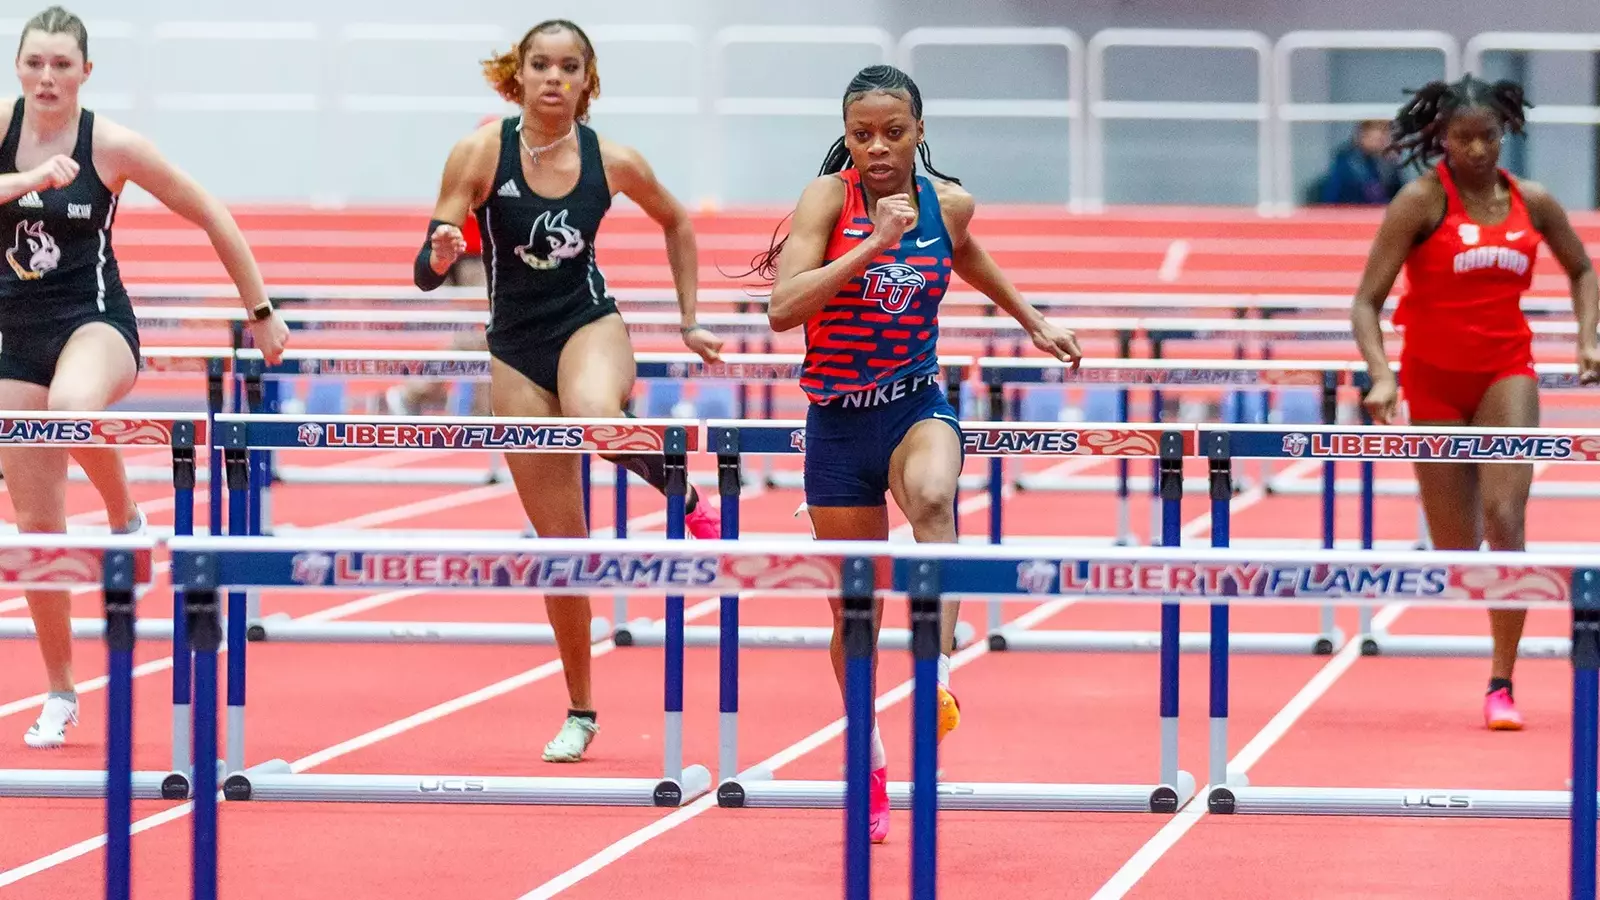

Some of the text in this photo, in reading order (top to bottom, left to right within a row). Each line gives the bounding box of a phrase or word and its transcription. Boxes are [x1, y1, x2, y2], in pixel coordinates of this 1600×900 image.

[863, 269, 920, 313] LU
[842, 379, 906, 409] NIKE
[419, 779, 485, 792] UCS
[1403, 795, 1470, 808] UCS
